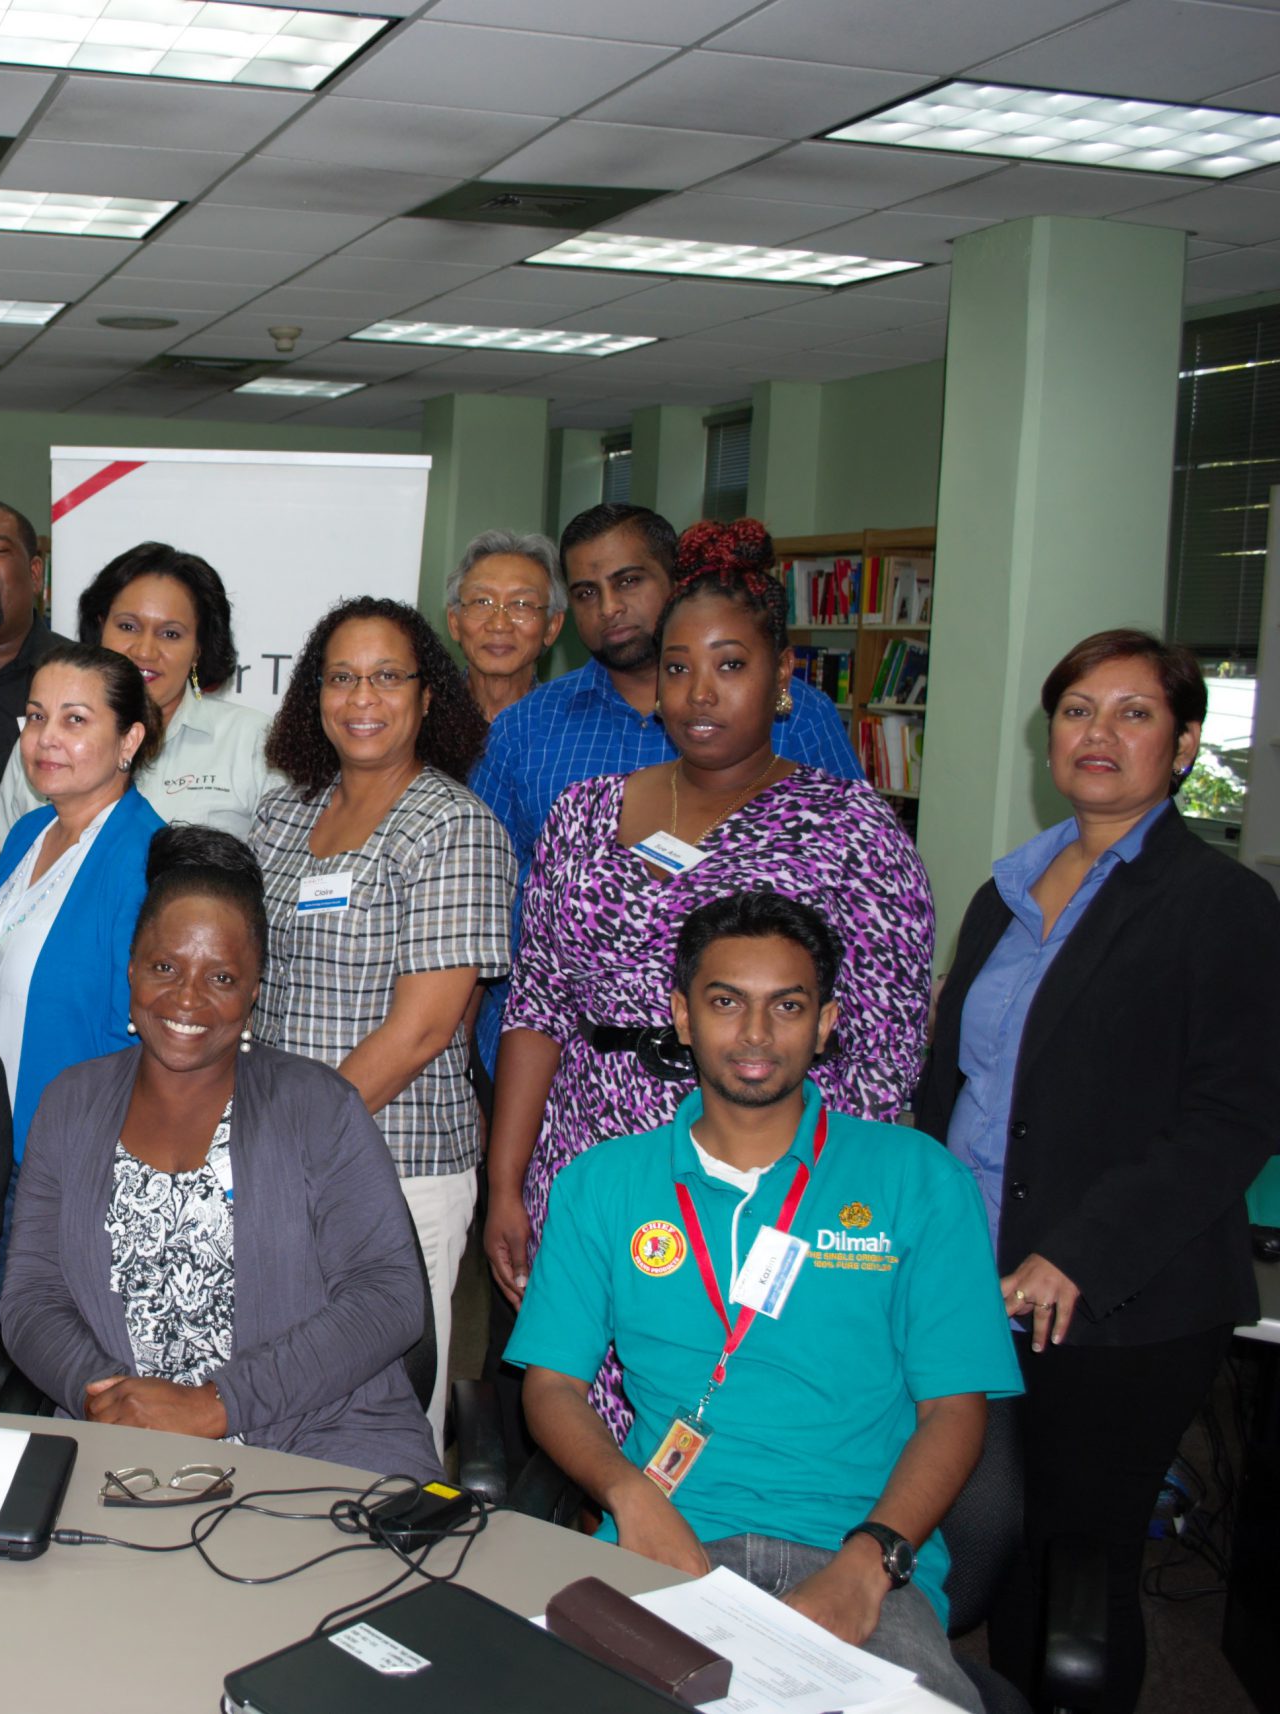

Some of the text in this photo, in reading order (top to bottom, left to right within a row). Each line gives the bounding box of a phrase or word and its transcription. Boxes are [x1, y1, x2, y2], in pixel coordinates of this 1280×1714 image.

[314, 888, 334, 897] Claire
[641, 1221, 677, 1233] CHIEF
[816, 1229, 892, 1253] Dilmah
